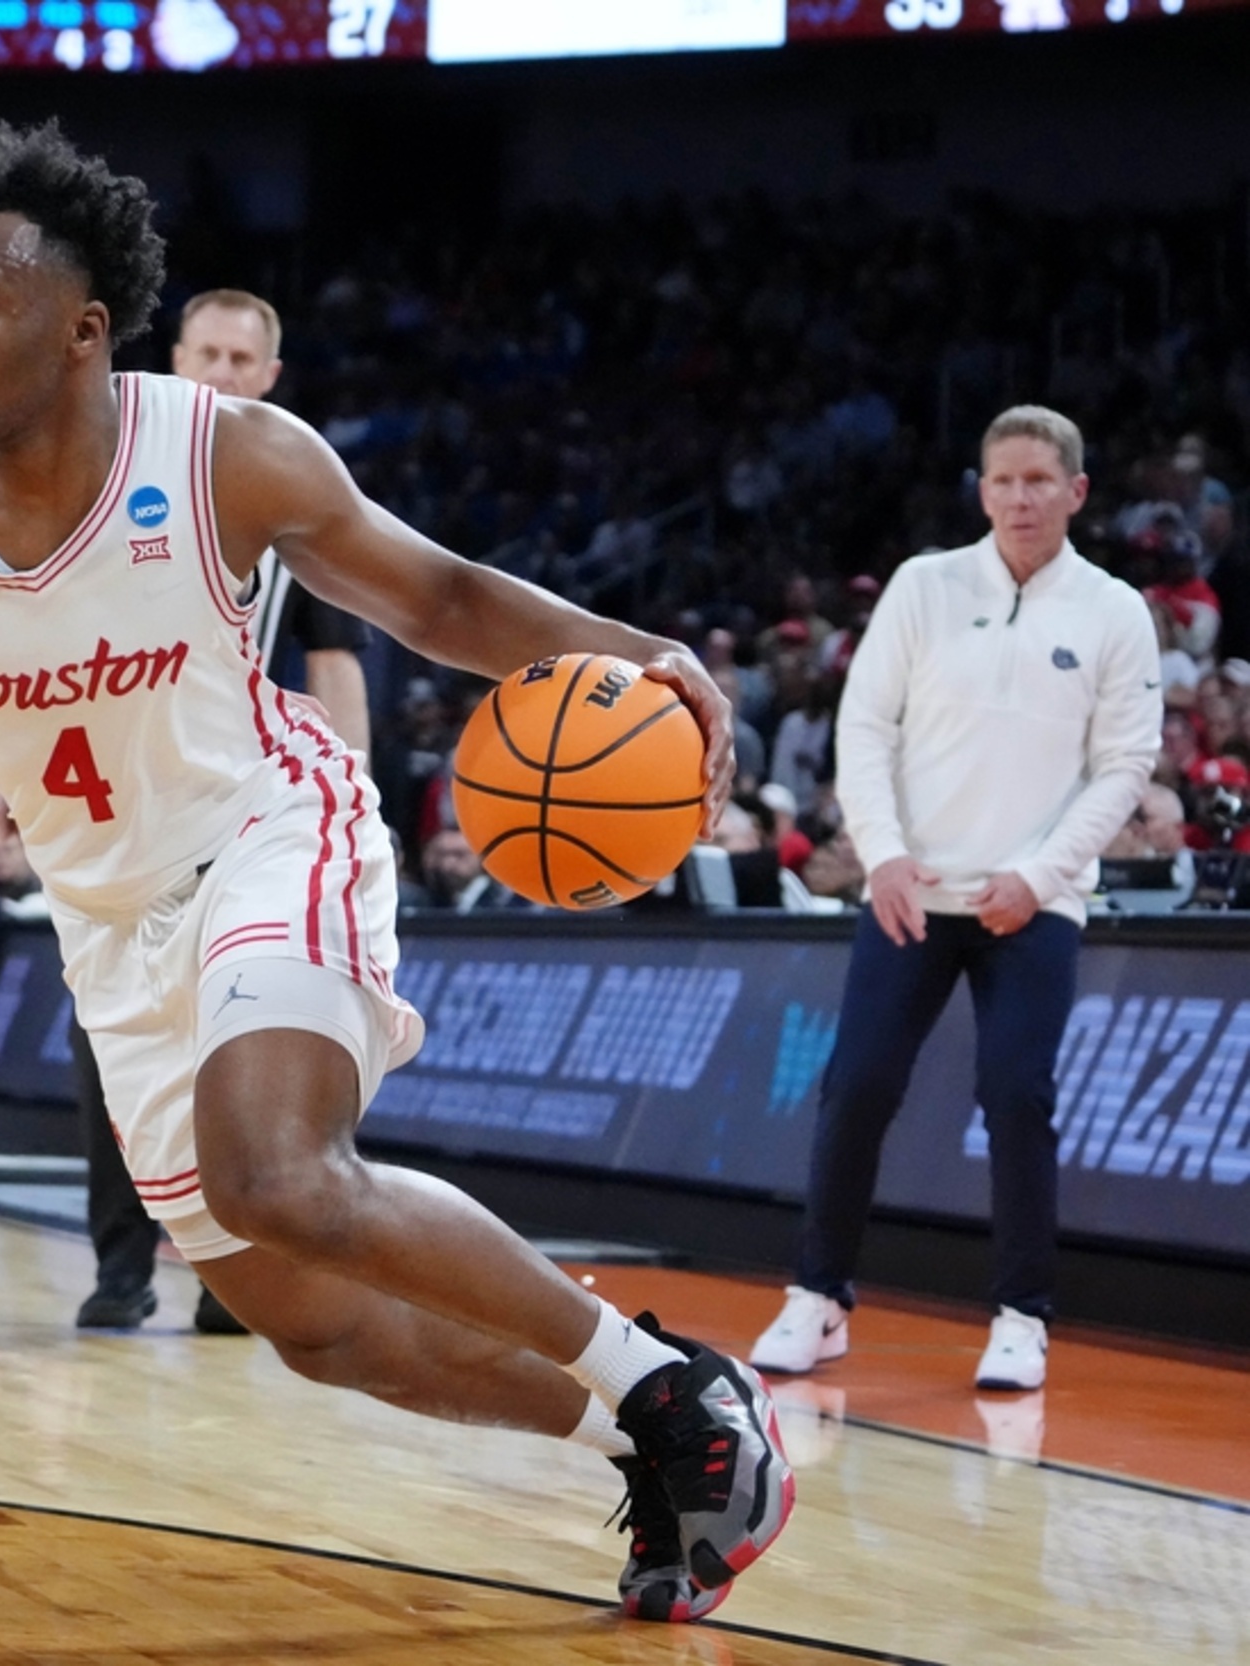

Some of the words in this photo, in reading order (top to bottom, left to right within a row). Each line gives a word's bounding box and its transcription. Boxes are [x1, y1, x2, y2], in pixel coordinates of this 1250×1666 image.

[328, 0, 395, 58] 27
[134, 502, 167, 520] NCAA
[42, 726, 114, 823] 4
